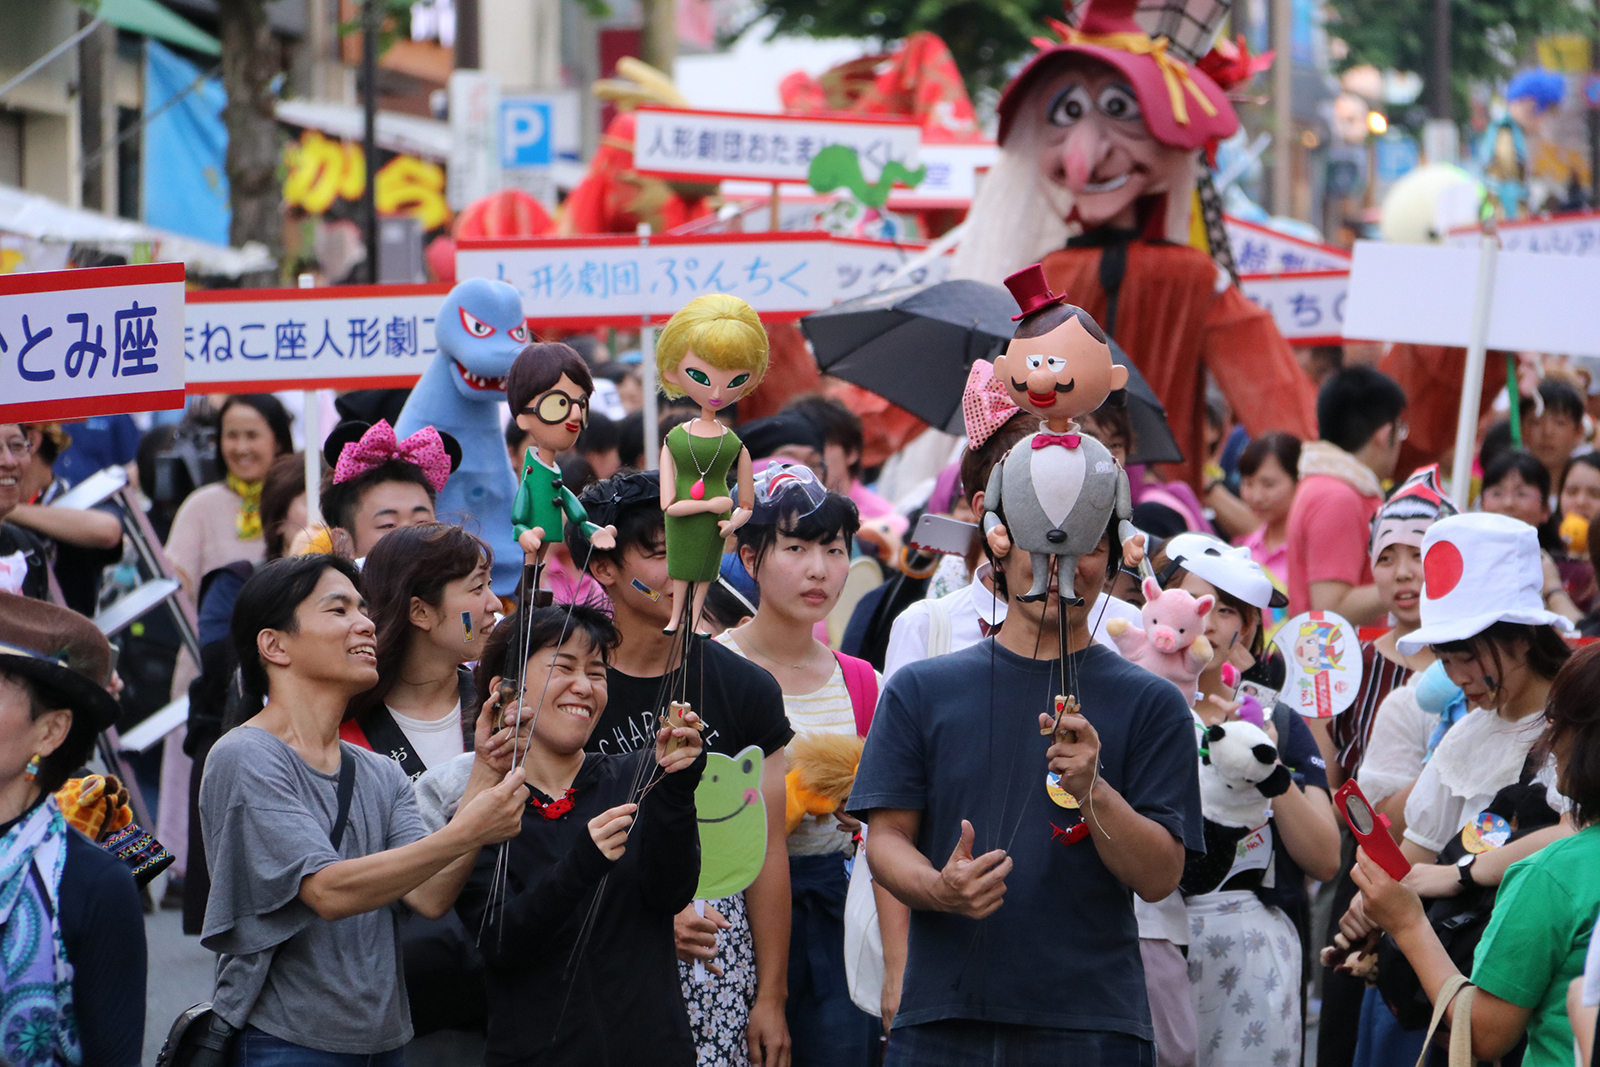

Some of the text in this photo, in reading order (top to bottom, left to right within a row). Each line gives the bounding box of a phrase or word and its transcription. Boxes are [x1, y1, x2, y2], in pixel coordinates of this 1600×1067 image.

[505, 108, 544, 161] P
[646, 125, 907, 173] 人形劇団おたまくし
[0, 300, 159, 382] とみ座
[1245, 832, 1265, 851] No.1
